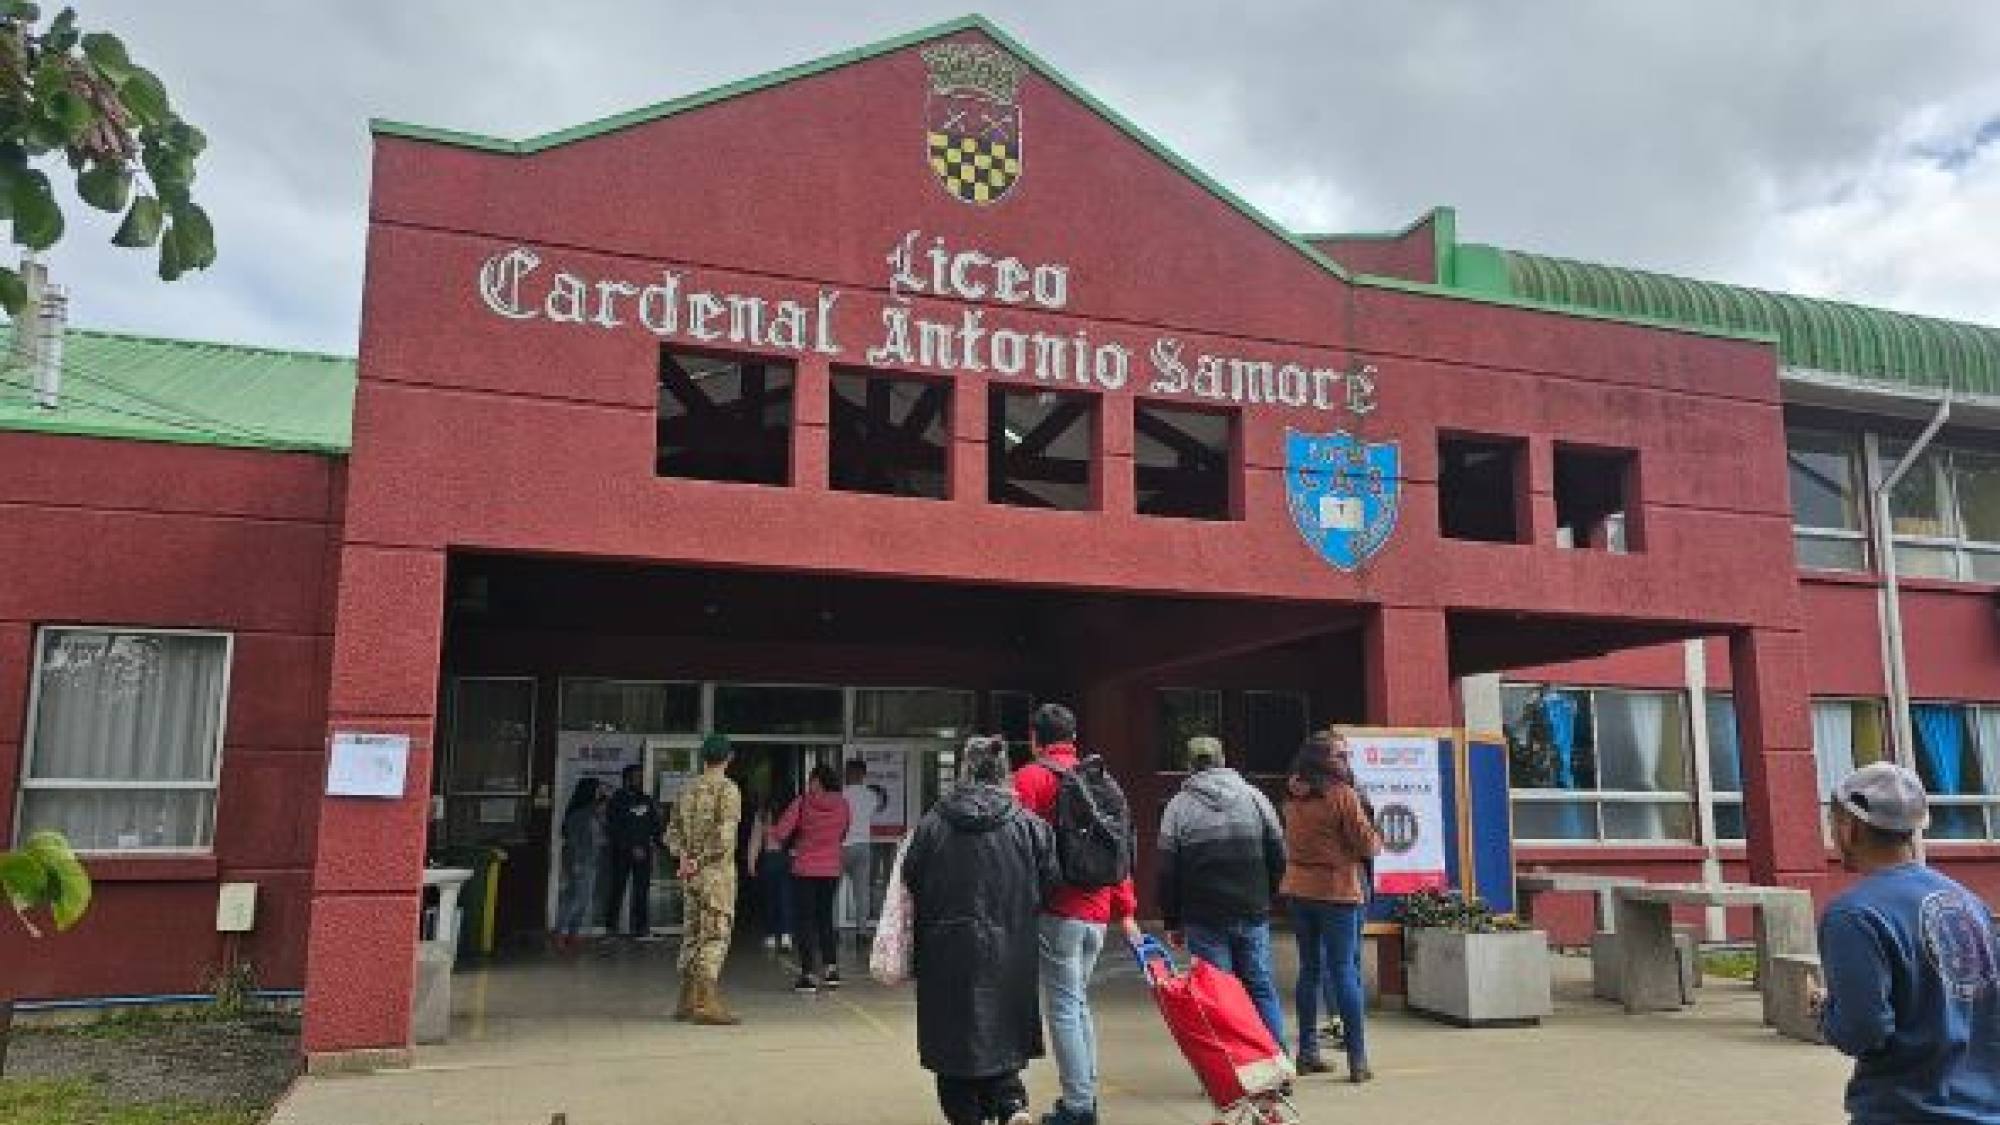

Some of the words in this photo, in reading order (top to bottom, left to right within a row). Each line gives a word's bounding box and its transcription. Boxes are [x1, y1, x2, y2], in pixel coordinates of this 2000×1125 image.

[479, 247, 843, 353] Cardenal
[866, 299, 1131, 391] Antonio
[887, 229, 1069, 307] Liceo
